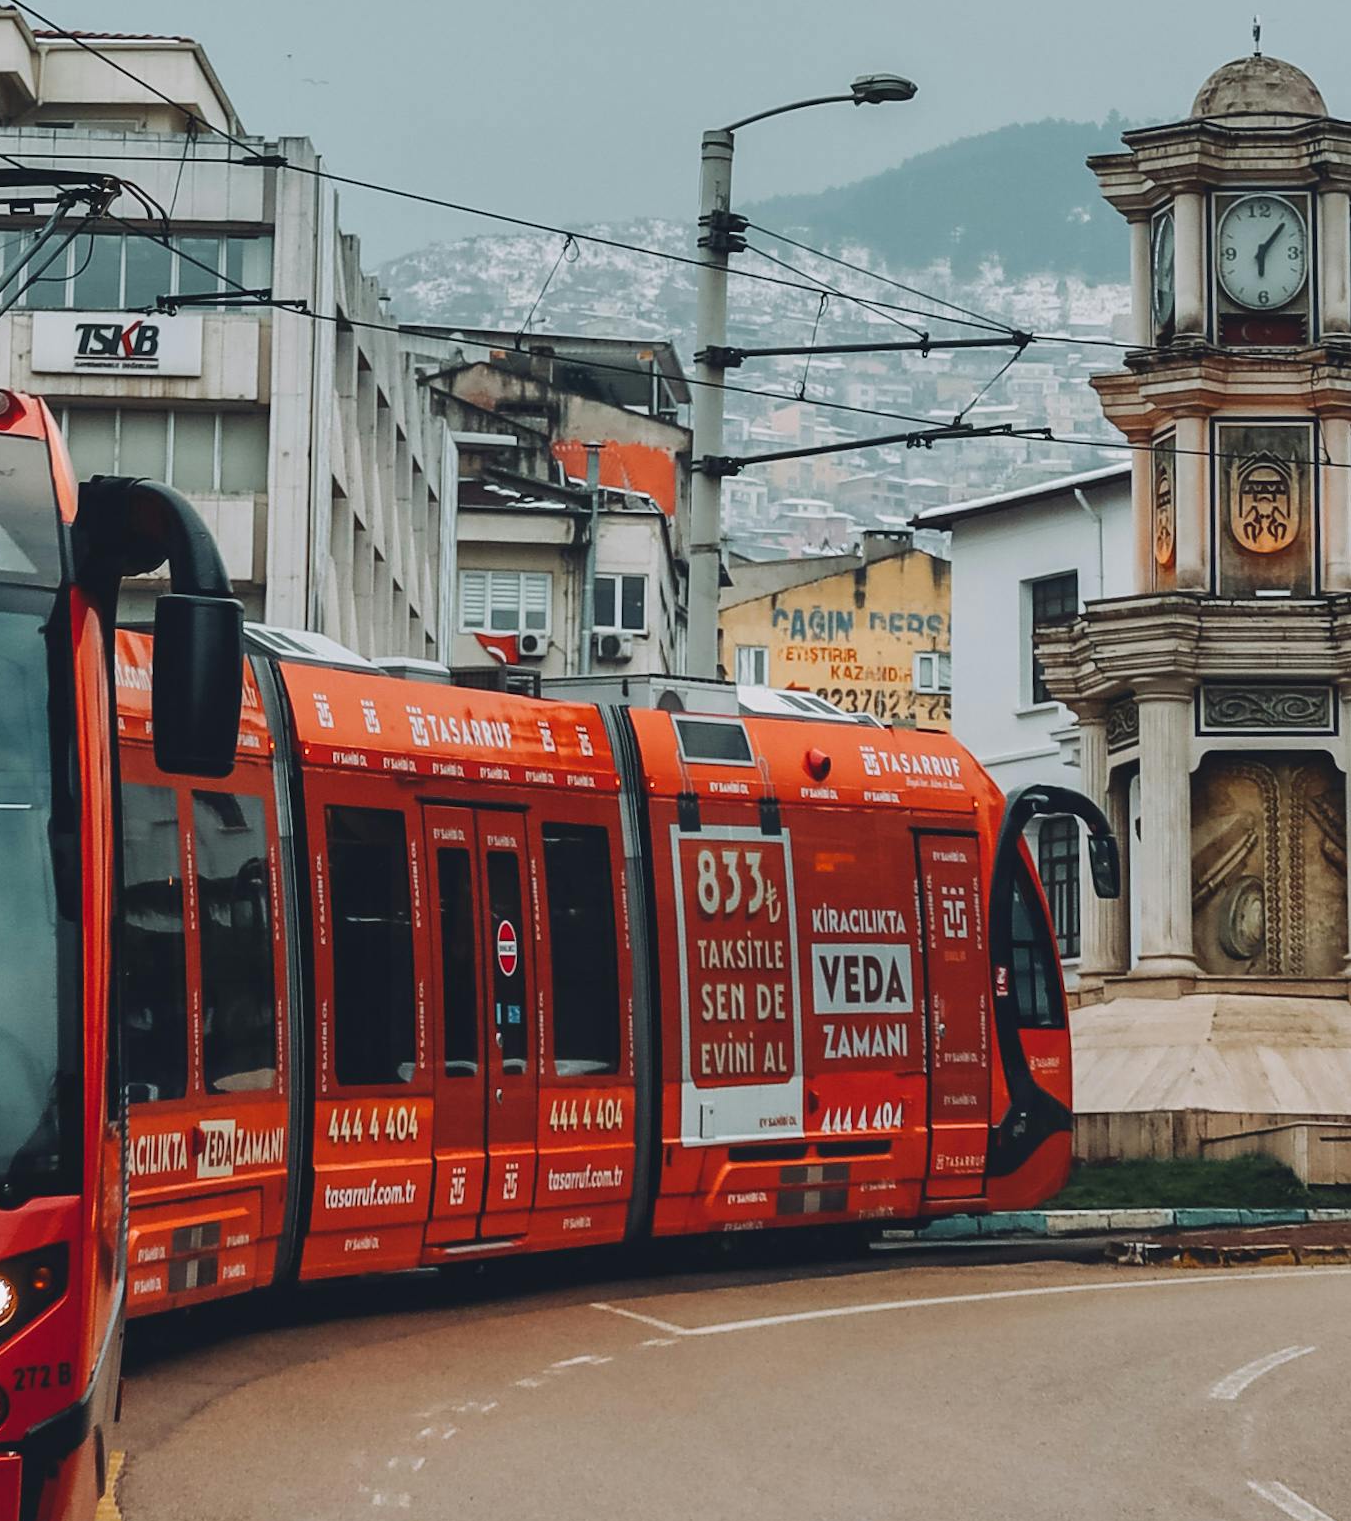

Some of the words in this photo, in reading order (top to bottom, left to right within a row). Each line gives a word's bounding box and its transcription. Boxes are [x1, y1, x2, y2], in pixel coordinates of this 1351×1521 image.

[1248, 204, 1271, 218] 12
[1225, 247, 1237, 261] 9
[1287, 246, 1298, 260] 3
[1258, 291, 1270, 304] 6
[75, 320, 160, 358] TSKB
[427, 714, 512, 750] TASARRUF
[879, 754, 961, 778] TASARRUF
[811, 902, 907, 935] KİRACILIKTA
[697, 931, 784, 969] TAKSİTLE
[818, 955, 907, 1004] VEDA
[701, 983, 746, 1020] SEN
[756, 984, 786, 1020] DE
[701, 1032, 755, 1075] EVİNİ
[763, 1043, 787, 1074] AL
[823, 1023, 908, 1059] ZAMANI
[328, 1107, 363, 1143] 444
[368, 1107, 380, 1141] 4
[385, 1105, 419, 1141] 404
[550, 1099, 578, 1132] 444
[582, 1098, 591, 1131] 4
[596, 1098, 623, 1130] 404
[820, 1106, 853, 1135] 444
[857, 1104, 868, 1133] 4
[872, 1102, 903, 1131] 404
[129, 1132, 188, 1176] ACILIKTA
[235, 1127, 285, 1166] ZAMANI
[324, 1178, 416, 1209] tasarruf.com.tr
[548, 1163, 623, 1191] tasarruf.com.tr
[12, 1365, 51, 1391] 272
[58, 1361, 72, 1387] B
